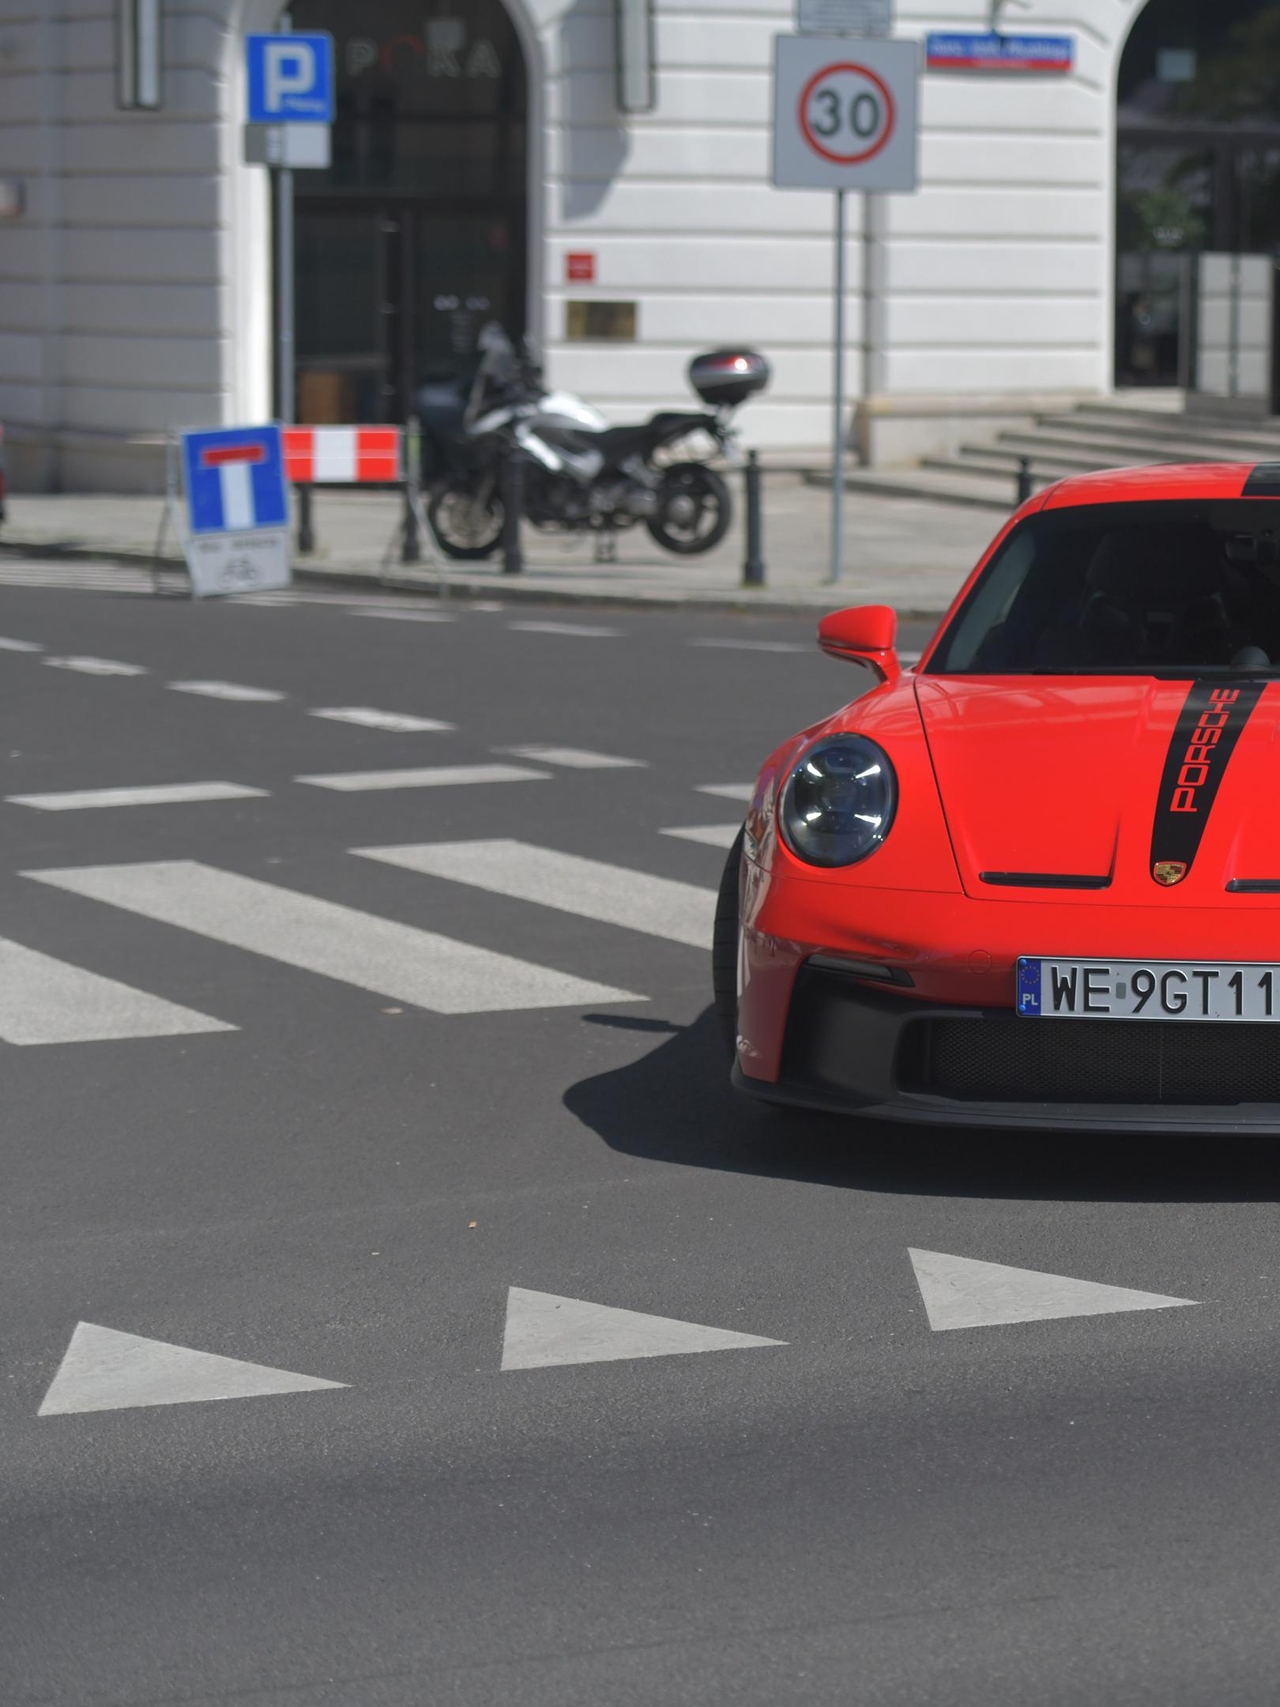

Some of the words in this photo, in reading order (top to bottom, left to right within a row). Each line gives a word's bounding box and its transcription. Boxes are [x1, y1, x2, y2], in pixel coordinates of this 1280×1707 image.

[264, 42, 315, 113] P
[812, 88, 880, 139] 30
[1169, 688, 1240, 813] PORSCHE
[1022, 993, 1039, 1006] PL
[1051, 965, 1111, 1013] WE
[1131, 968, 1273, 1016] 9GT11
